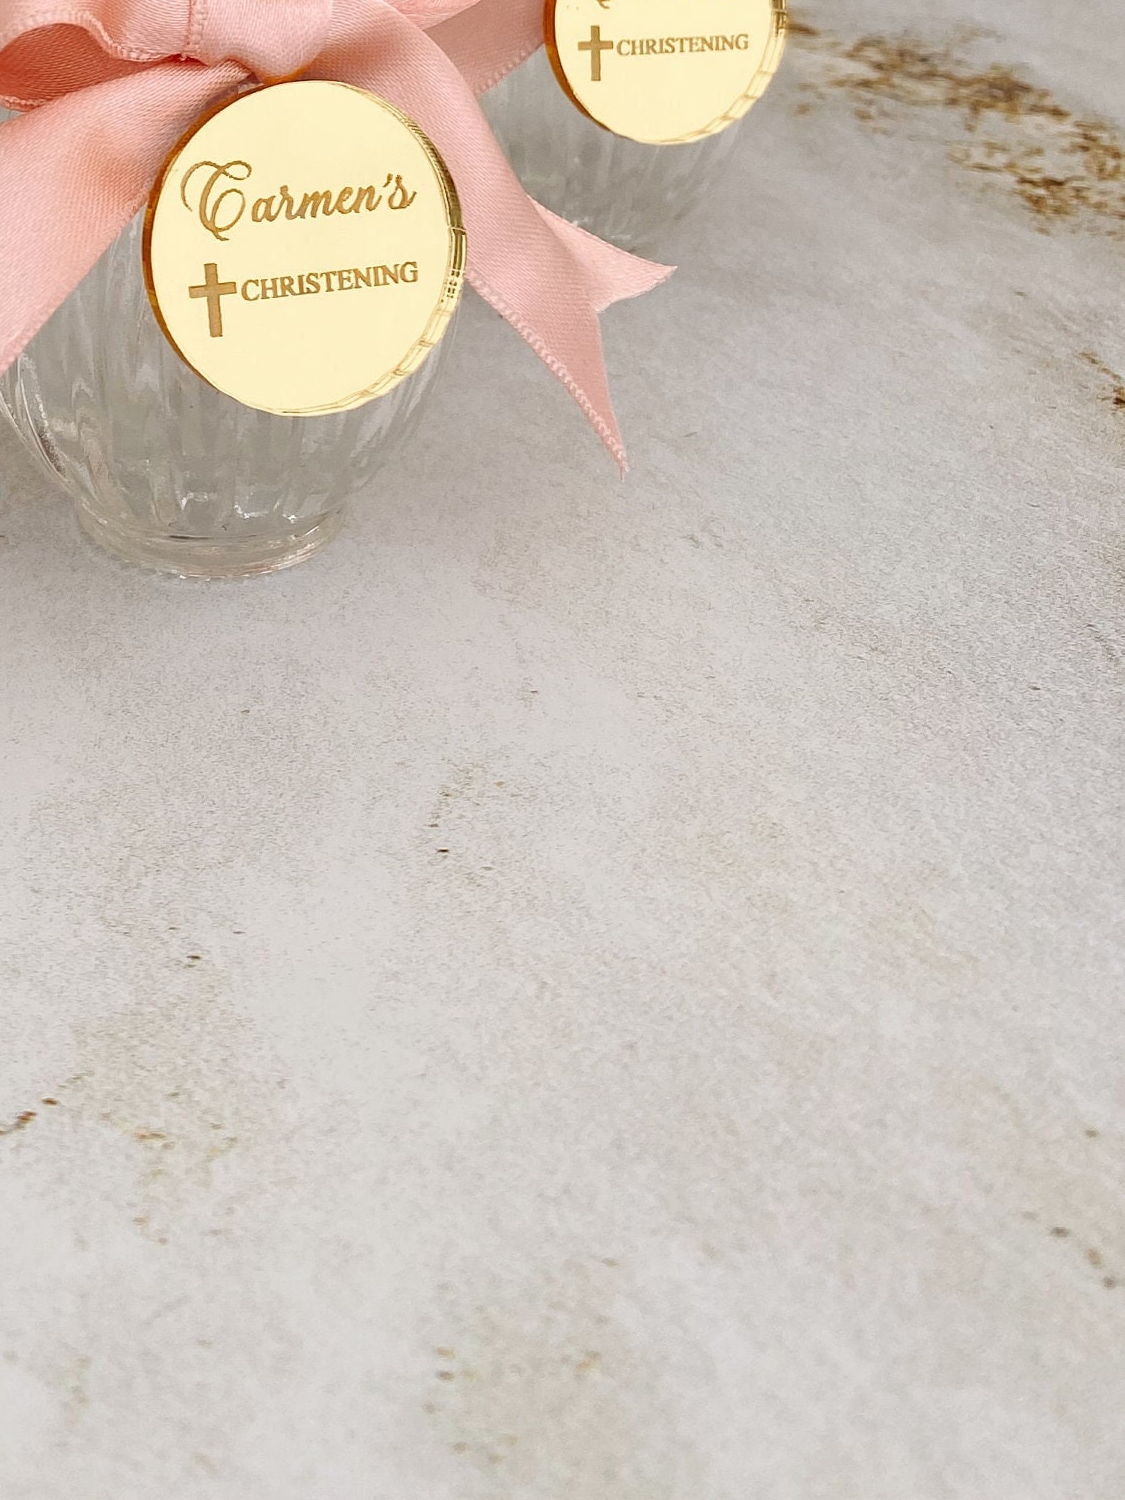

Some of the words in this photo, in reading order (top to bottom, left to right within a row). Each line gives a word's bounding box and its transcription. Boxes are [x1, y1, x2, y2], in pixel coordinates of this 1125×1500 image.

[616, 33, 750, 56] CHRISTENING
[181, 160, 417, 241] Carmen's
[241, 261, 419, 301] CHRISTENING
